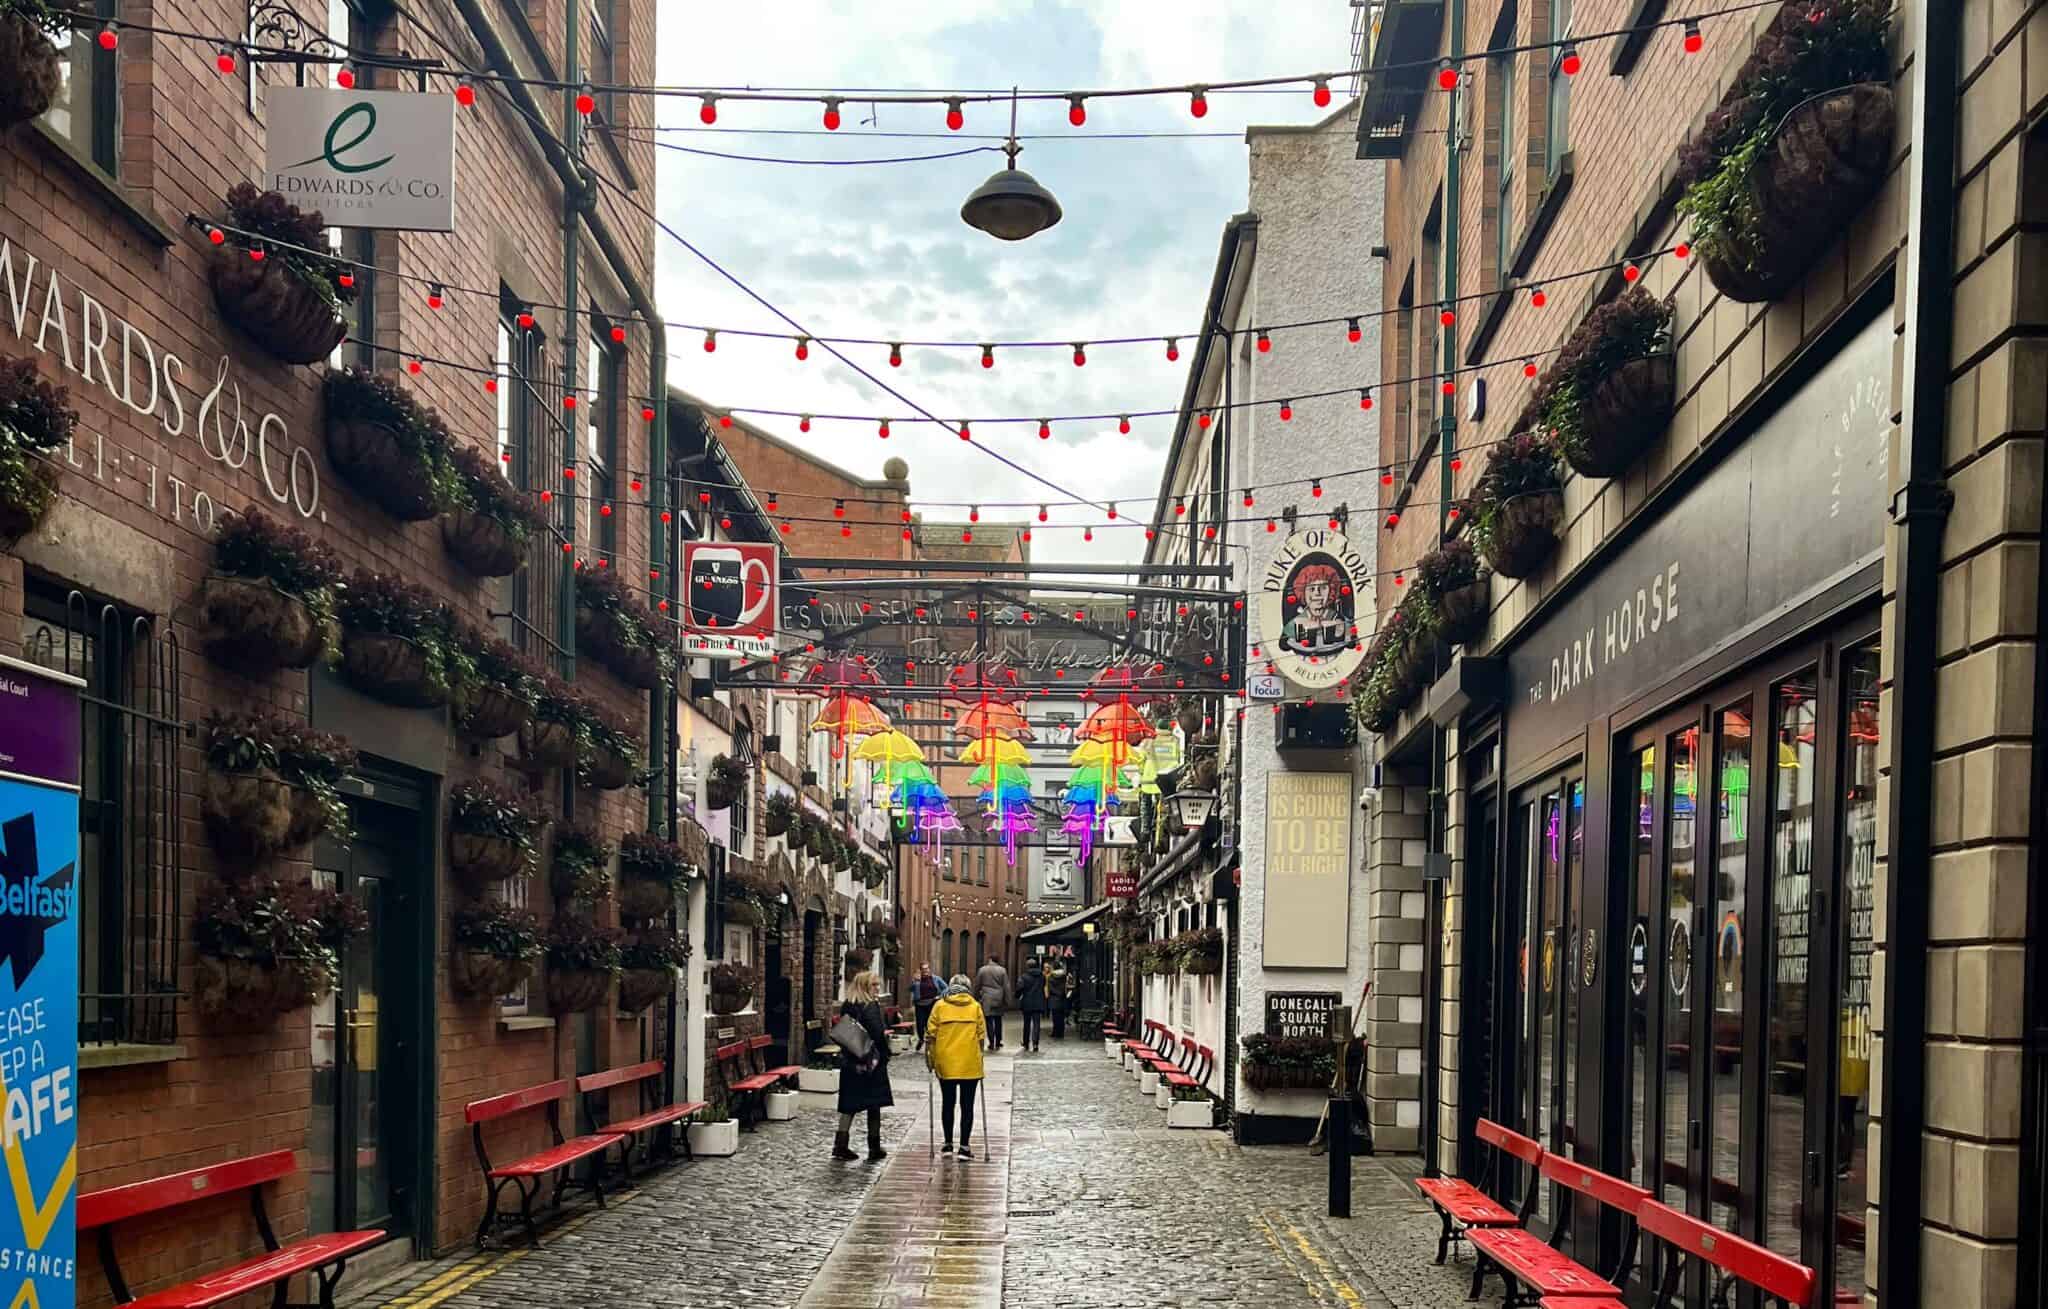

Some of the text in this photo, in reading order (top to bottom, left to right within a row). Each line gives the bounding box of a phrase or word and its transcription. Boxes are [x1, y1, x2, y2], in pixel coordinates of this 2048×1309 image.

[275, 174, 374, 196] EDWARDS
[198, 354, 249, 469] &
[1263, 530, 1372, 593] DUKE OF YORK
[1530, 561, 1681, 705] THE DARK HORSE
[10, 680, 29, 697] Court
[1254, 683, 1281, 696] focus
[1272, 794, 1345, 816] IS GOING
[1272, 819, 1345, 854] TO BE
[1279, 1011, 1328, 1025] SQUARE
[1282, 1025, 1324, 1038] NORTH
[31, 1039, 45, 1073] A
[0, 1065, 75, 1149] AFE
